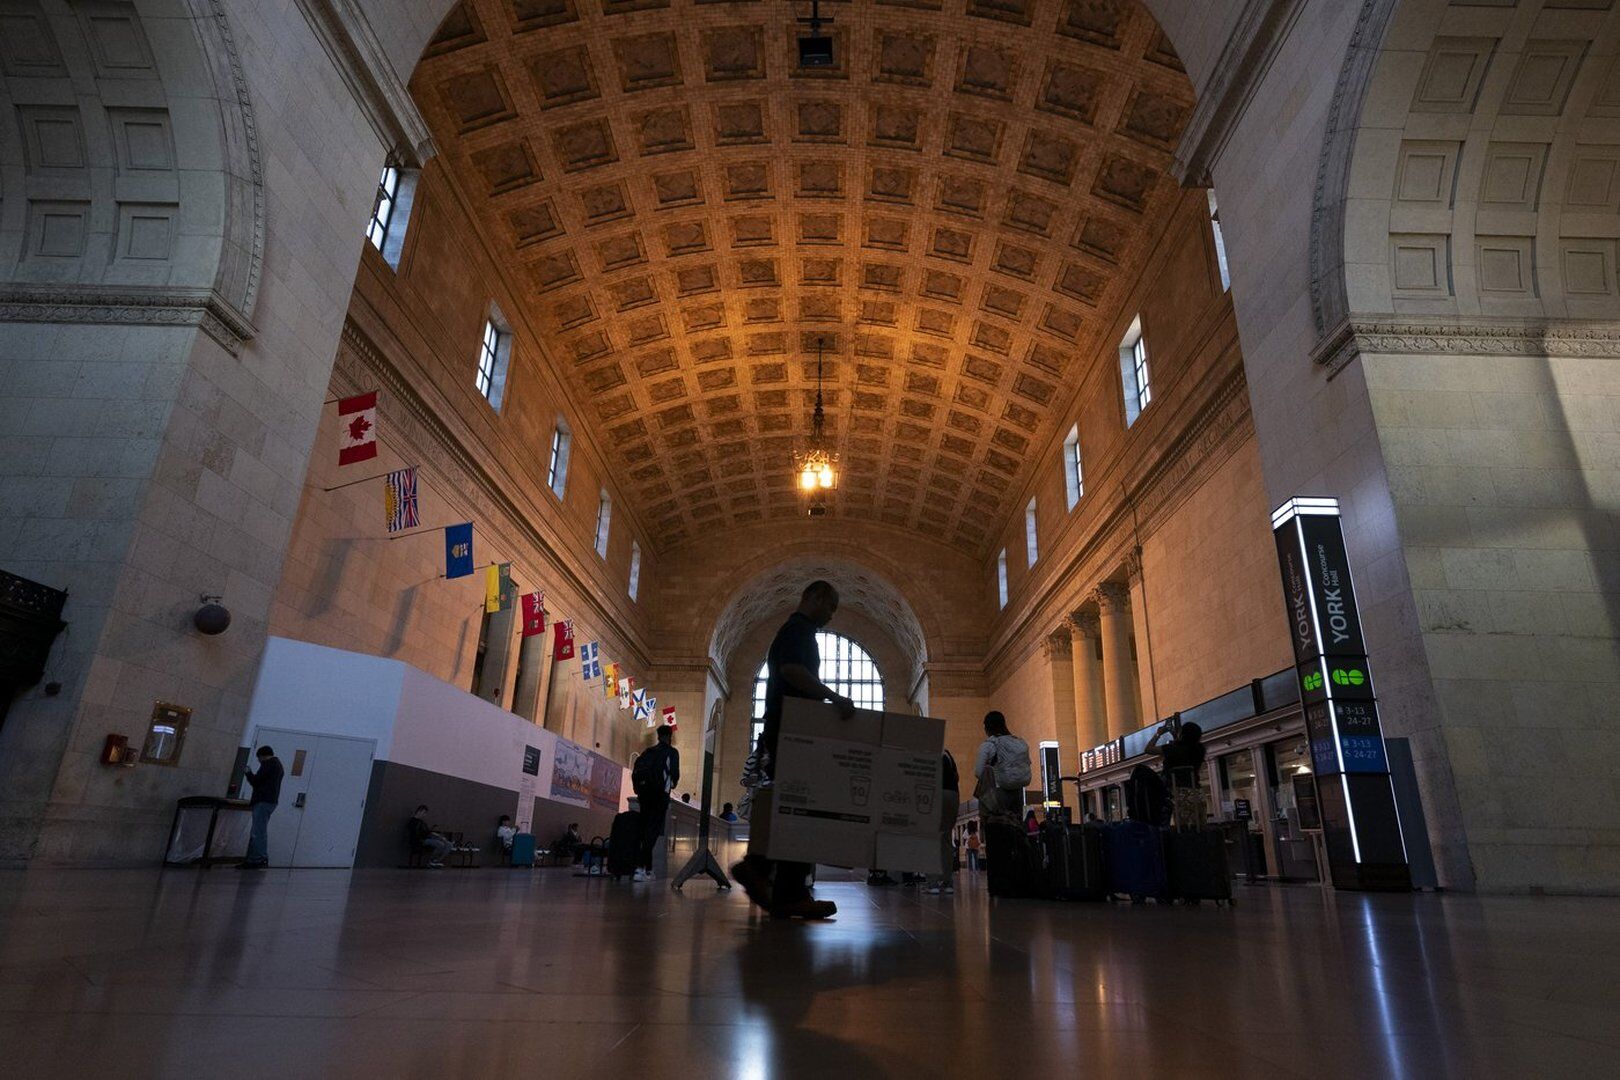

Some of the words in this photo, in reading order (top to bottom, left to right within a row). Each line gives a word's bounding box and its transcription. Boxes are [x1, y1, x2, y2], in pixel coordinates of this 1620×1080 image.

[1318, 544, 1330, 586] Concourse
[1329, 568, 1340, 586] Hall
[1294, 591, 1311, 650] YORK
[1324, 589, 1349, 643] YORK
[1332, 668, 1364, 686] GO
[1345, 706, 1366, 715] 3-13
[1347, 717, 1372, 726] 24-27
[852, 785, 866, 797] 10
[916, 793, 930, 805] 10
